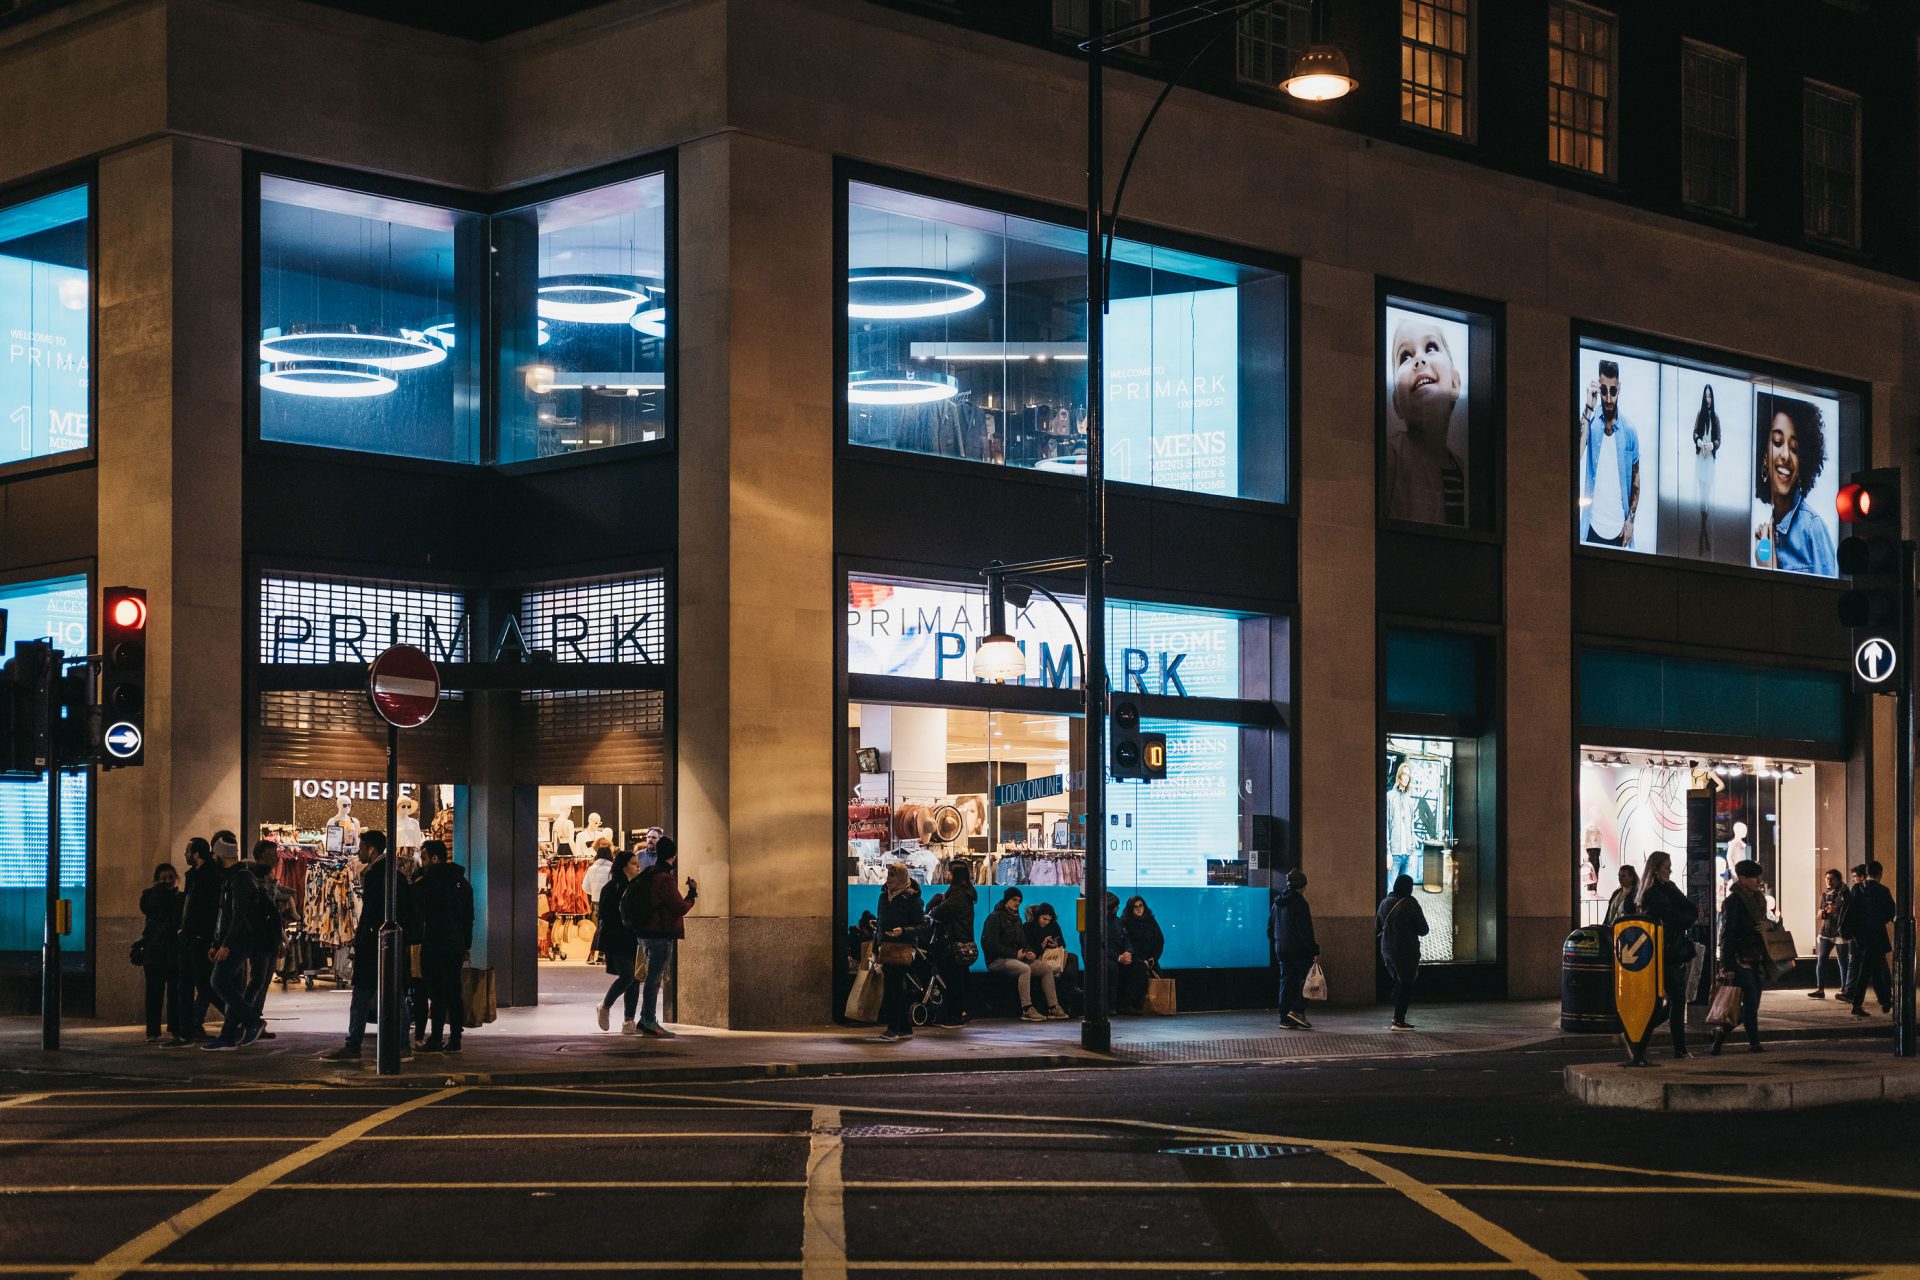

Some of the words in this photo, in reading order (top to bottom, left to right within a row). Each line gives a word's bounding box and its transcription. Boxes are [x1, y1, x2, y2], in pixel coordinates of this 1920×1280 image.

[10, 329, 54, 344] WELCOME
[54, 336, 67, 347] TO
[1110, 368, 1152, 379] WELCOME
[1153, 366, 1165, 376] TO
[1110, 374, 1226, 401] PRIMARK
[1177, 399, 1212, 409] OXFORD
[1110, 437, 1132, 481] 1
[1148, 431, 1226, 459] MENS
[1185, 455, 1226, 469] SHOES
[848, 601, 1037, 637] PRIMAK
[272, 612, 656, 665] PRIMARK
[1150, 629, 1227, 653] HOME
[934, 631, 1189, 698] PIMRK
[1166, 738, 1228, 755] OMENS
[1001, 782, 1027, 805] LOOK
[1027, 775, 1062, 800] ONLINE
[1065, 770, 1087, 793] SHO
